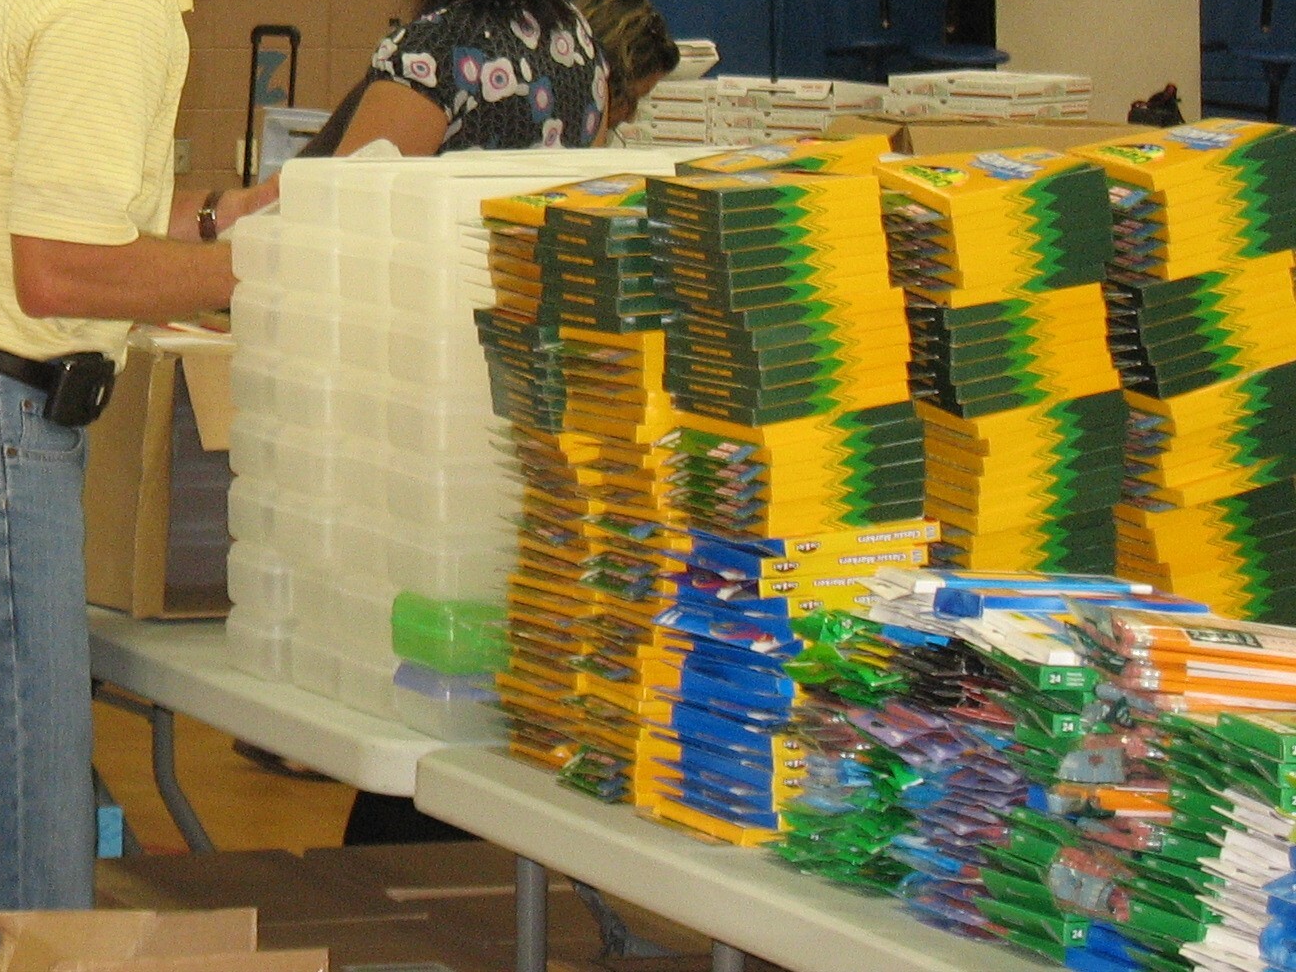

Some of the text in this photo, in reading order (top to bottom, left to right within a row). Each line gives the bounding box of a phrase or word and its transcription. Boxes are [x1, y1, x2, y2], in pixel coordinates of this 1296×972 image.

[858, 533, 892, 543] Markers
[839, 555, 875, 565] Markers
[1049, 674, 1061, 684] 24
[1071, 929, 1083, 939] 24
